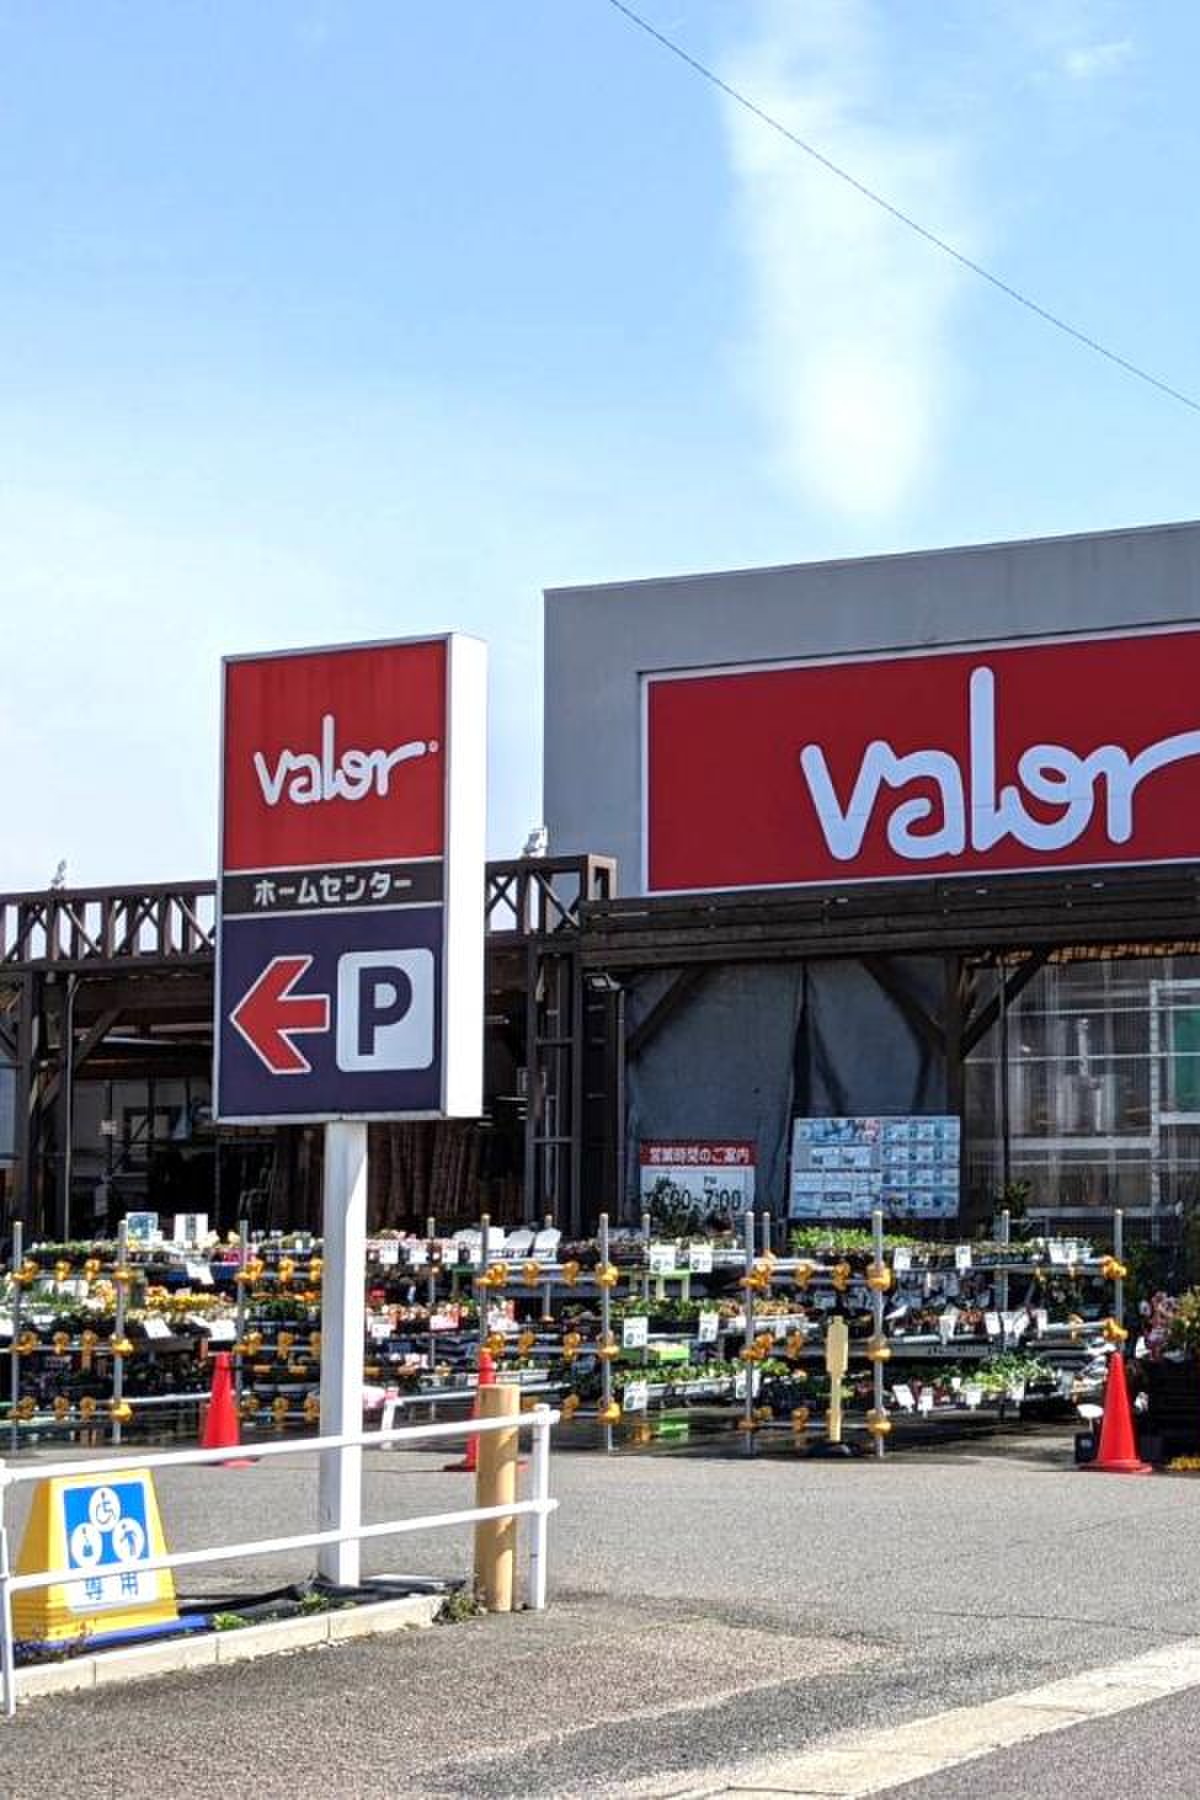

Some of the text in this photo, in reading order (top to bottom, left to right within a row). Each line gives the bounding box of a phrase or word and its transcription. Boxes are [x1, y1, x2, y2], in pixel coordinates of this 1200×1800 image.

[254, 871, 412, 907] ホームセンター
[358, 966, 413, 1057] P
